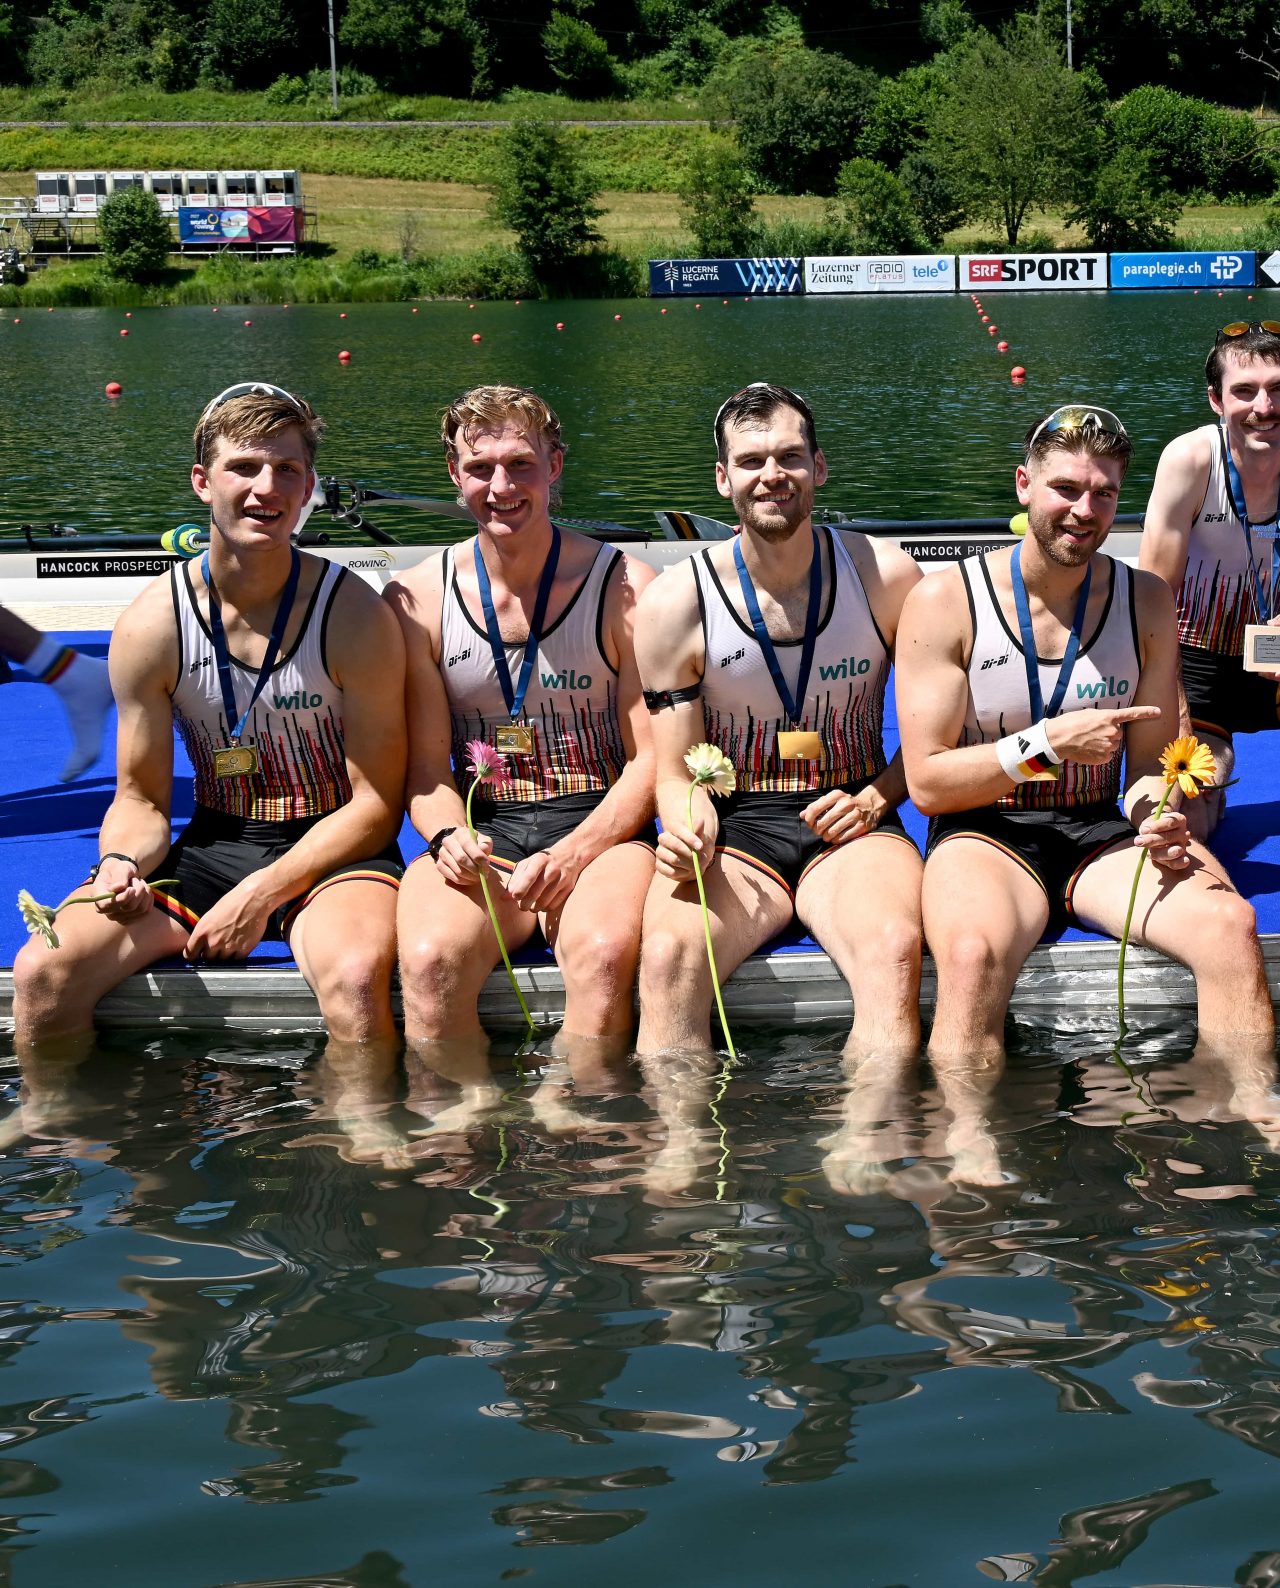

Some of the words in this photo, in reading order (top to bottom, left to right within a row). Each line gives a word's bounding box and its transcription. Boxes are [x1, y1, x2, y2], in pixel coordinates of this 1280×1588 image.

[811, 262, 861, 273] Luzerner
[971, 264, 999, 277] SRF
[1001, 258, 1098, 282] SPORT
[1123, 261, 1202, 278] paraplegie.ch
[682, 273, 720, 282] REGATTA
[811, 273, 854, 285] Zeitung
[904, 546, 962, 556] HANCOCK
[40, 561, 100, 573] HANCOCK
[105, 560, 178, 572] PROSPECTI
[348, 559, 387, 568] ROWING
[819, 656, 871, 681] wilo
[541, 669, 593, 690] wilo
[1076, 675, 1130, 699] wilo
[273, 690, 323, 710] wilo
